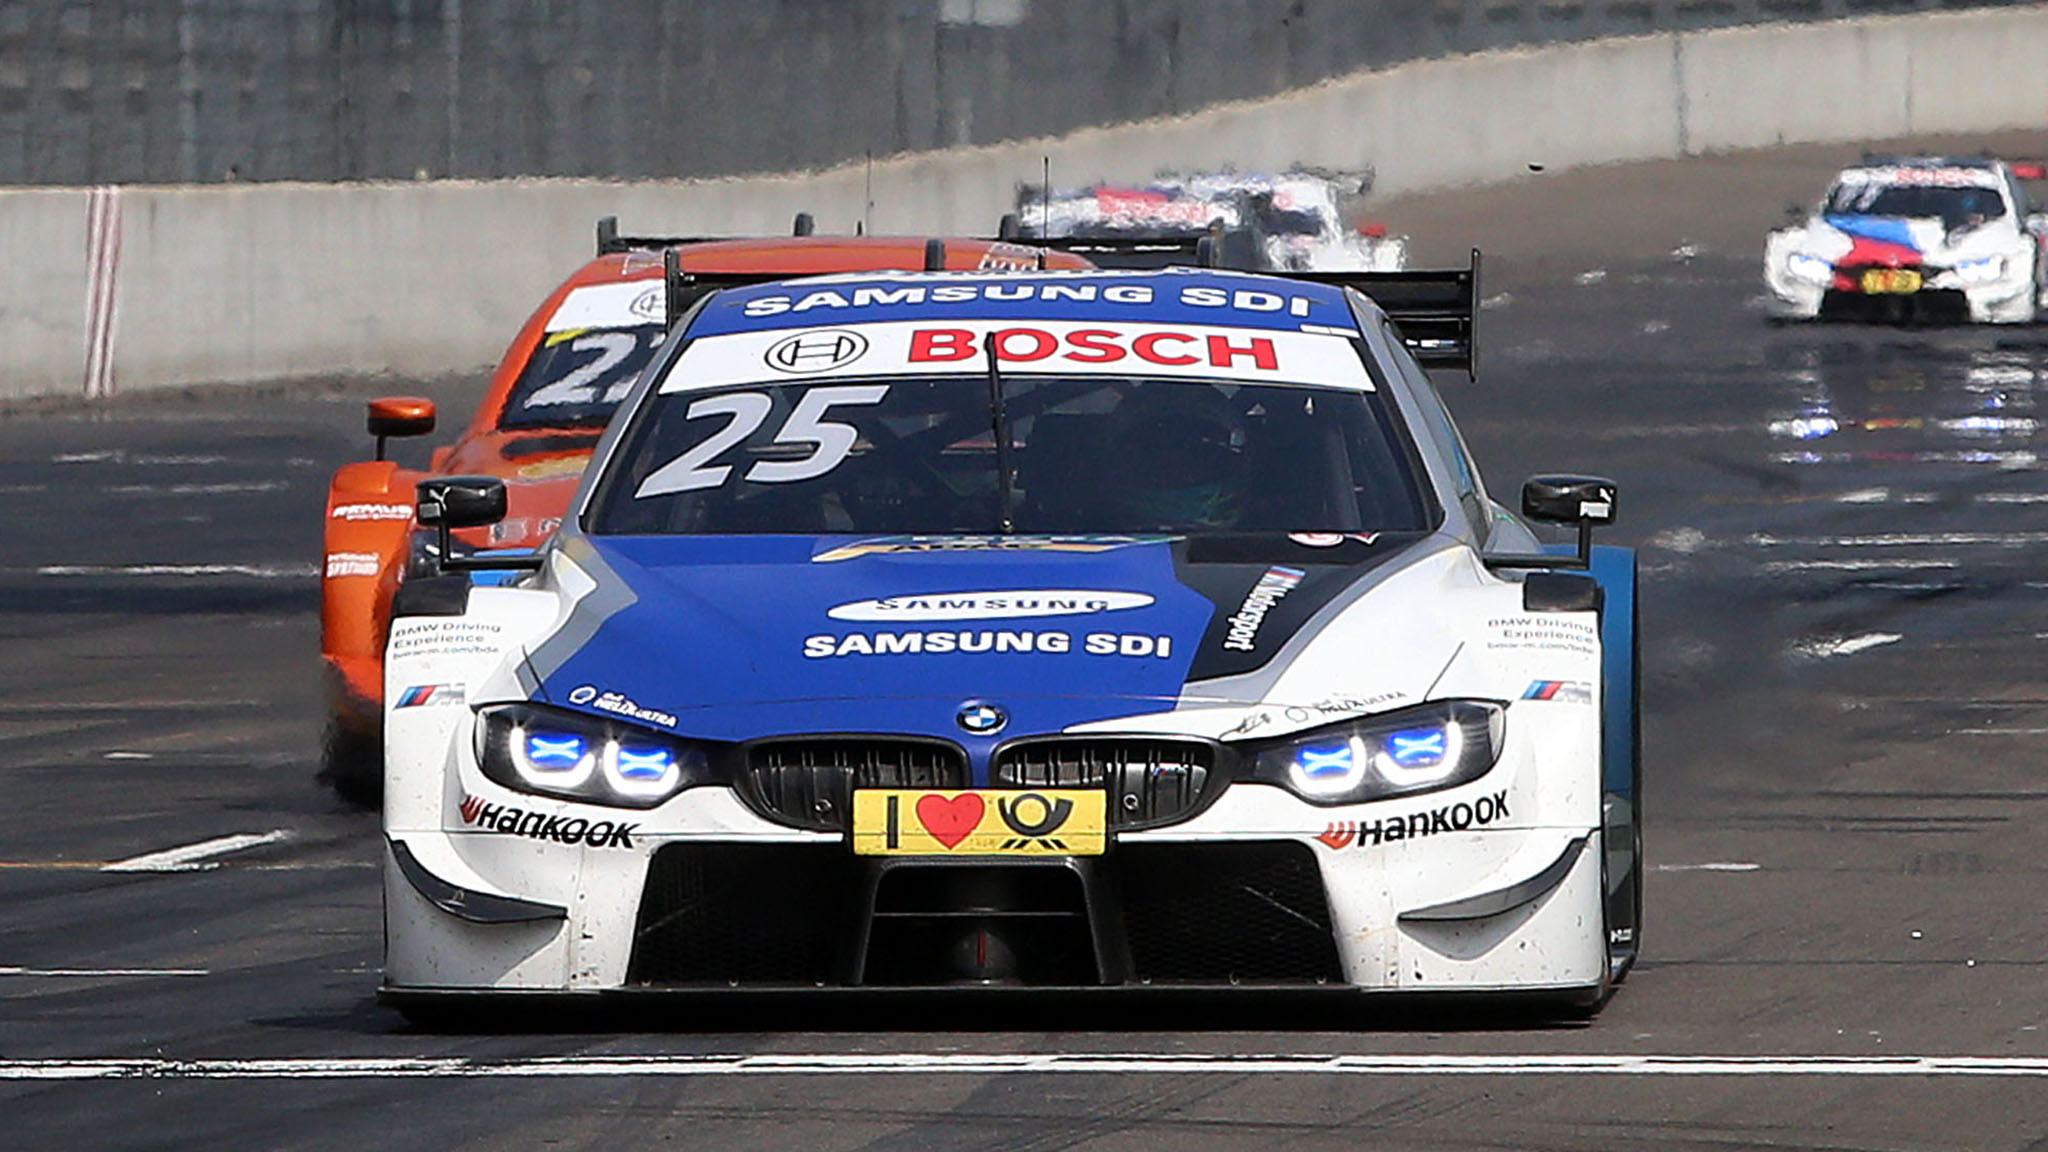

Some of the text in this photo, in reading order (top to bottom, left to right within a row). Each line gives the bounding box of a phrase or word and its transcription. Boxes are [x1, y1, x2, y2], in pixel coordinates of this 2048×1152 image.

[744, 286, 1310, 318] SAMSUNG SDI
[908, 328, 1279, 370] BOSCH
[635, 385, 889, 499] 25
[876, 599, 1109, 611] SAMSUNG
[395, 623, 501, 637] BMW Driving
[1488, 618, 1593, 634] BMW Driving
[394, 634, 485, 649] Experience
[803, 632, 1171, 657] SAMSUNG SDI
[1503, 630, 1593, 644] Experience
[886, 795, 899, 849] I
